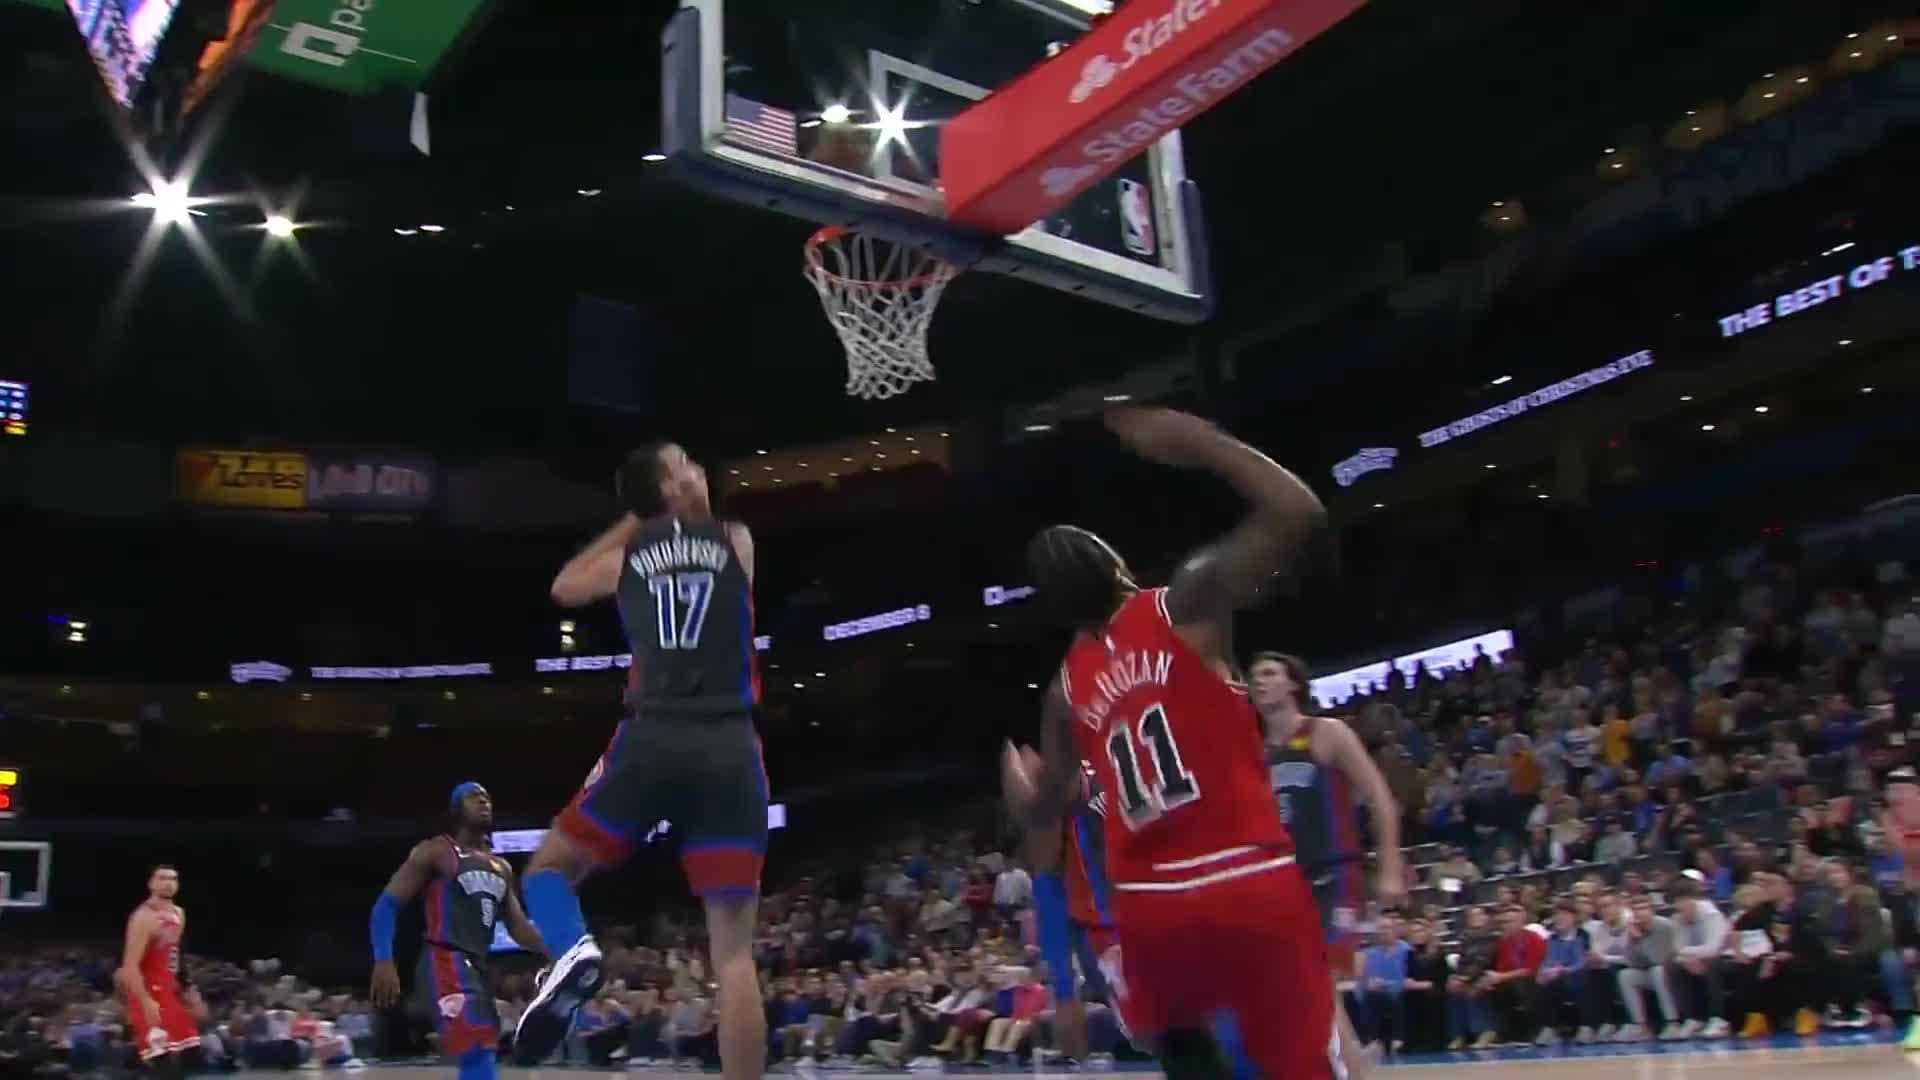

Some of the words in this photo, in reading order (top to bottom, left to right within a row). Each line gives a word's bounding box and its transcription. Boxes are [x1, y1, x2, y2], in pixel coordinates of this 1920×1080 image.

[1718, 302, 1772, 337] THE
[1775, 274, 1844, 317] BEST
[1848, 256, 1895, 288] OF
[647, 573, 714, 650] 17
[824, 606, 917, 640] DECEMBER
[1106, 702, 1201, 832] 11
